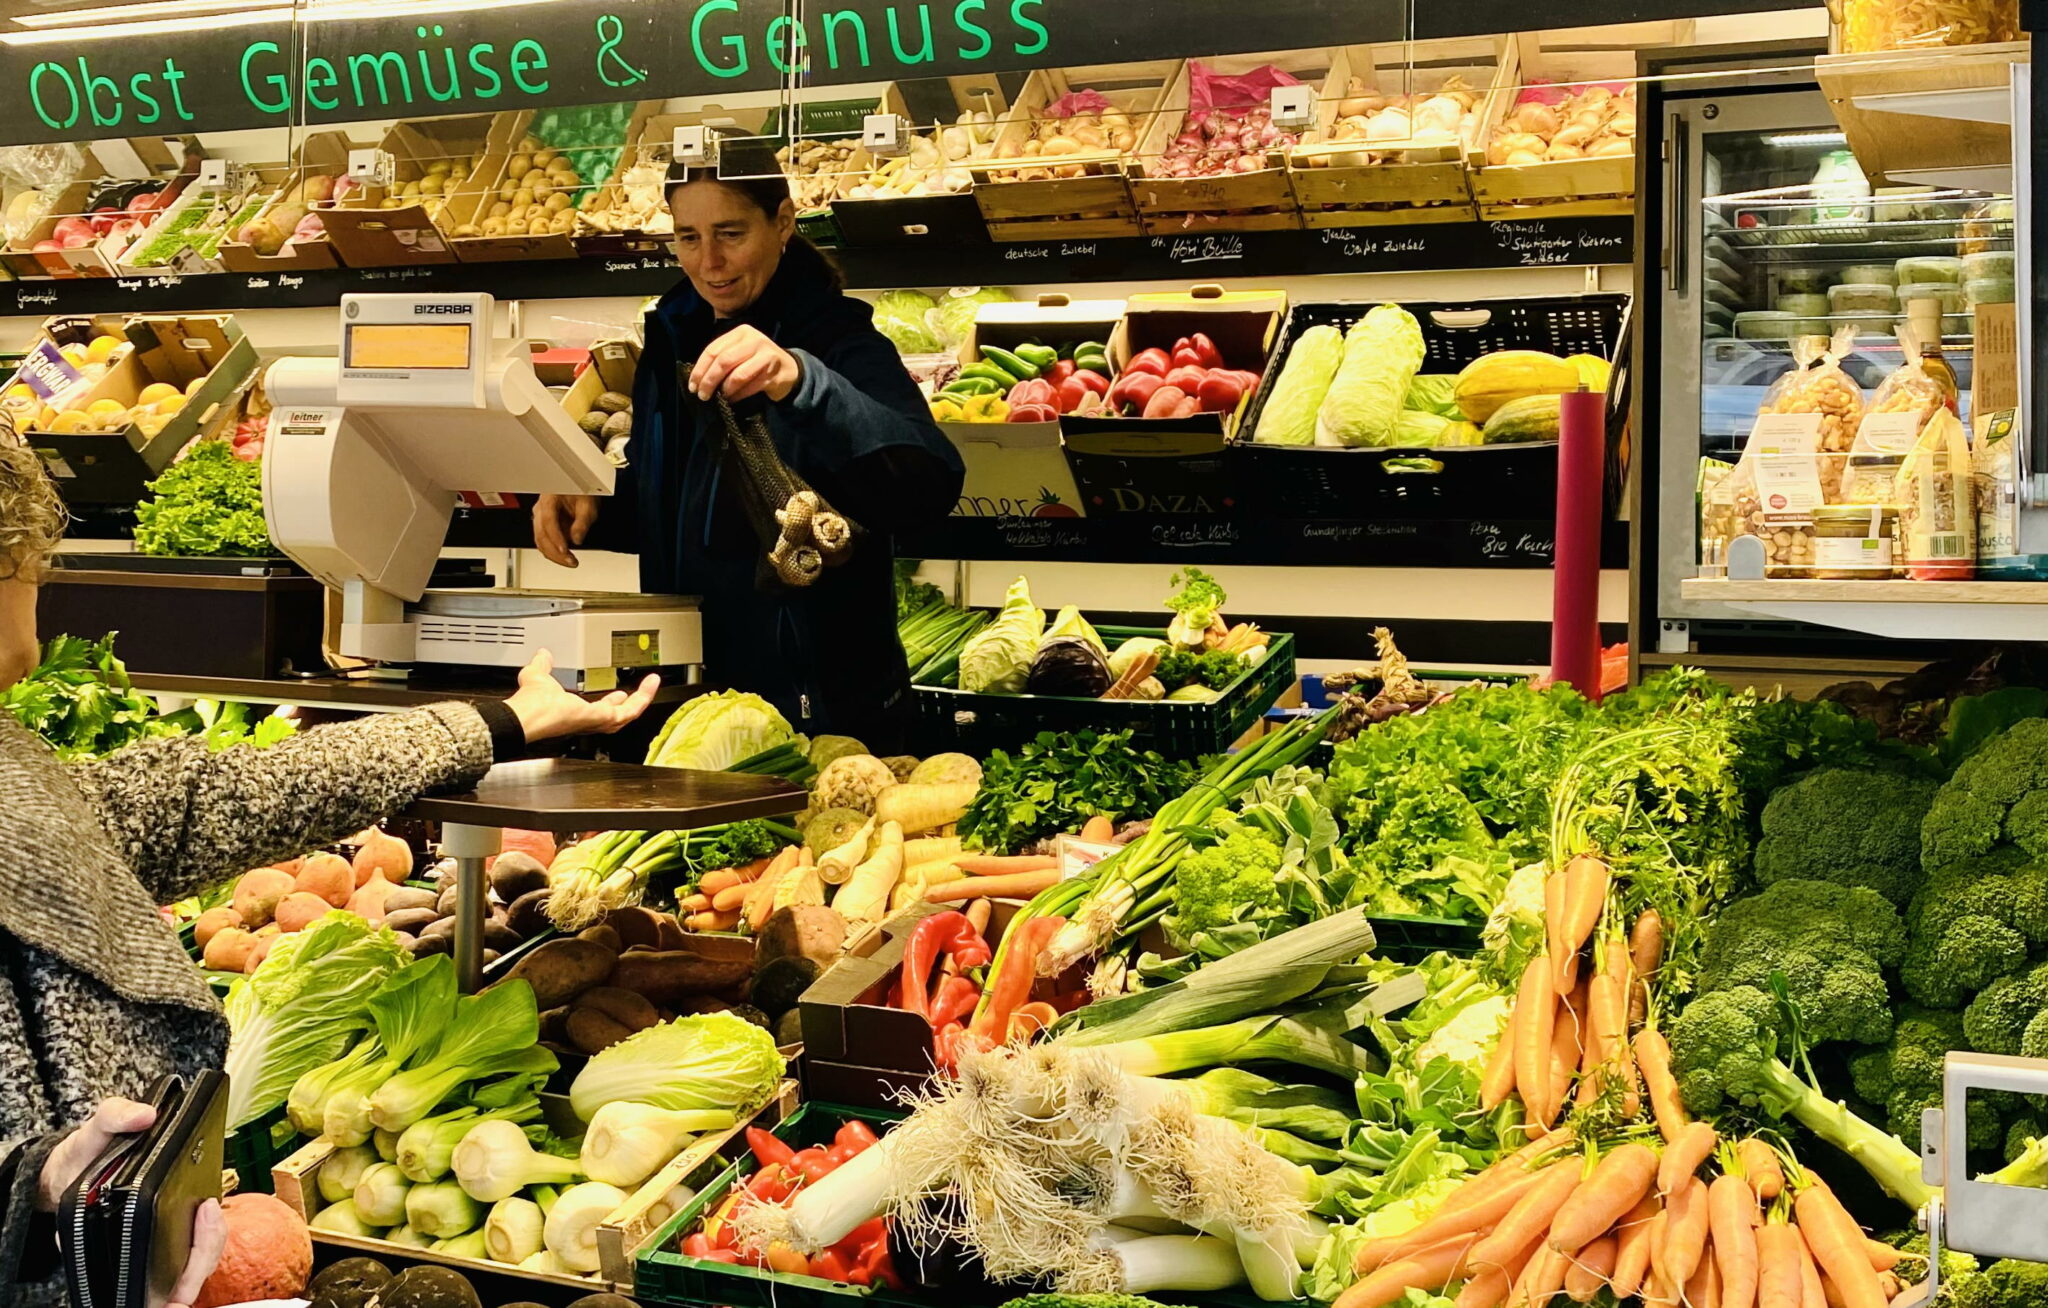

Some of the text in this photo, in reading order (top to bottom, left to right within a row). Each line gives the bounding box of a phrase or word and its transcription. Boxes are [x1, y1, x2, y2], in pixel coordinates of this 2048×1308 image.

[29, 0, 1049, 129] Obst Gemüse & Genuss
[1004, 243, 1096, 259] deutsche Zwiebel
[1202, 236, 1243, 258] Bülle
[414, 304, 473, 315] BIZERBA
[290, 412, 324, 423] leitner
[1110, 488, 1215, 513] DAZA
